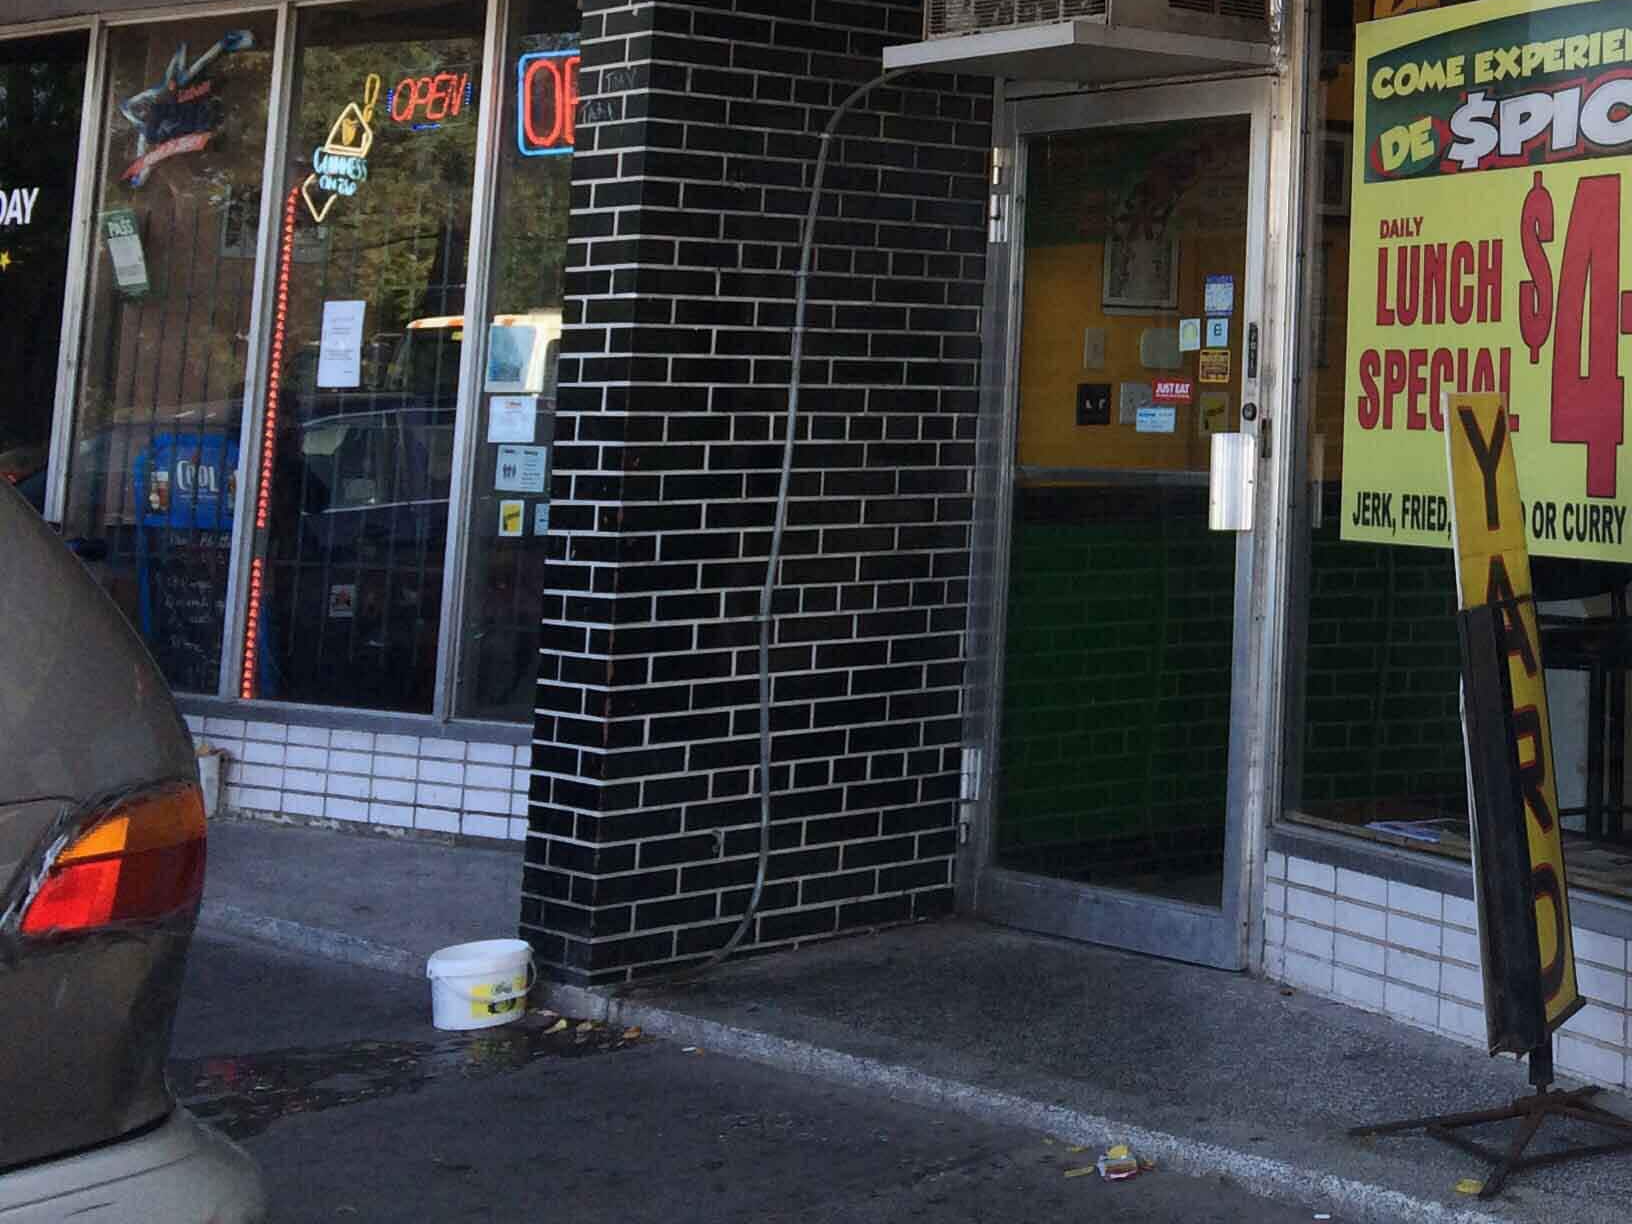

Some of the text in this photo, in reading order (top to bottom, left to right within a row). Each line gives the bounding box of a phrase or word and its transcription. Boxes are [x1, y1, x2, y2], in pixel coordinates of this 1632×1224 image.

[391, 71, 469, 122] OPEN
[524, 56, 580, 146] OP
[1371, 55, 1466, 100] COME
[1379, 117, 1435, 172] DE
[1379, 217, 1425, 239] DAILY
[1375, 239, 1503, 326] LUNCH
[1352, 491, 1397, 537] JERK,
[1532, 501, 1558, 541] OR
[1563, 502, 1627, 544] CURRY
